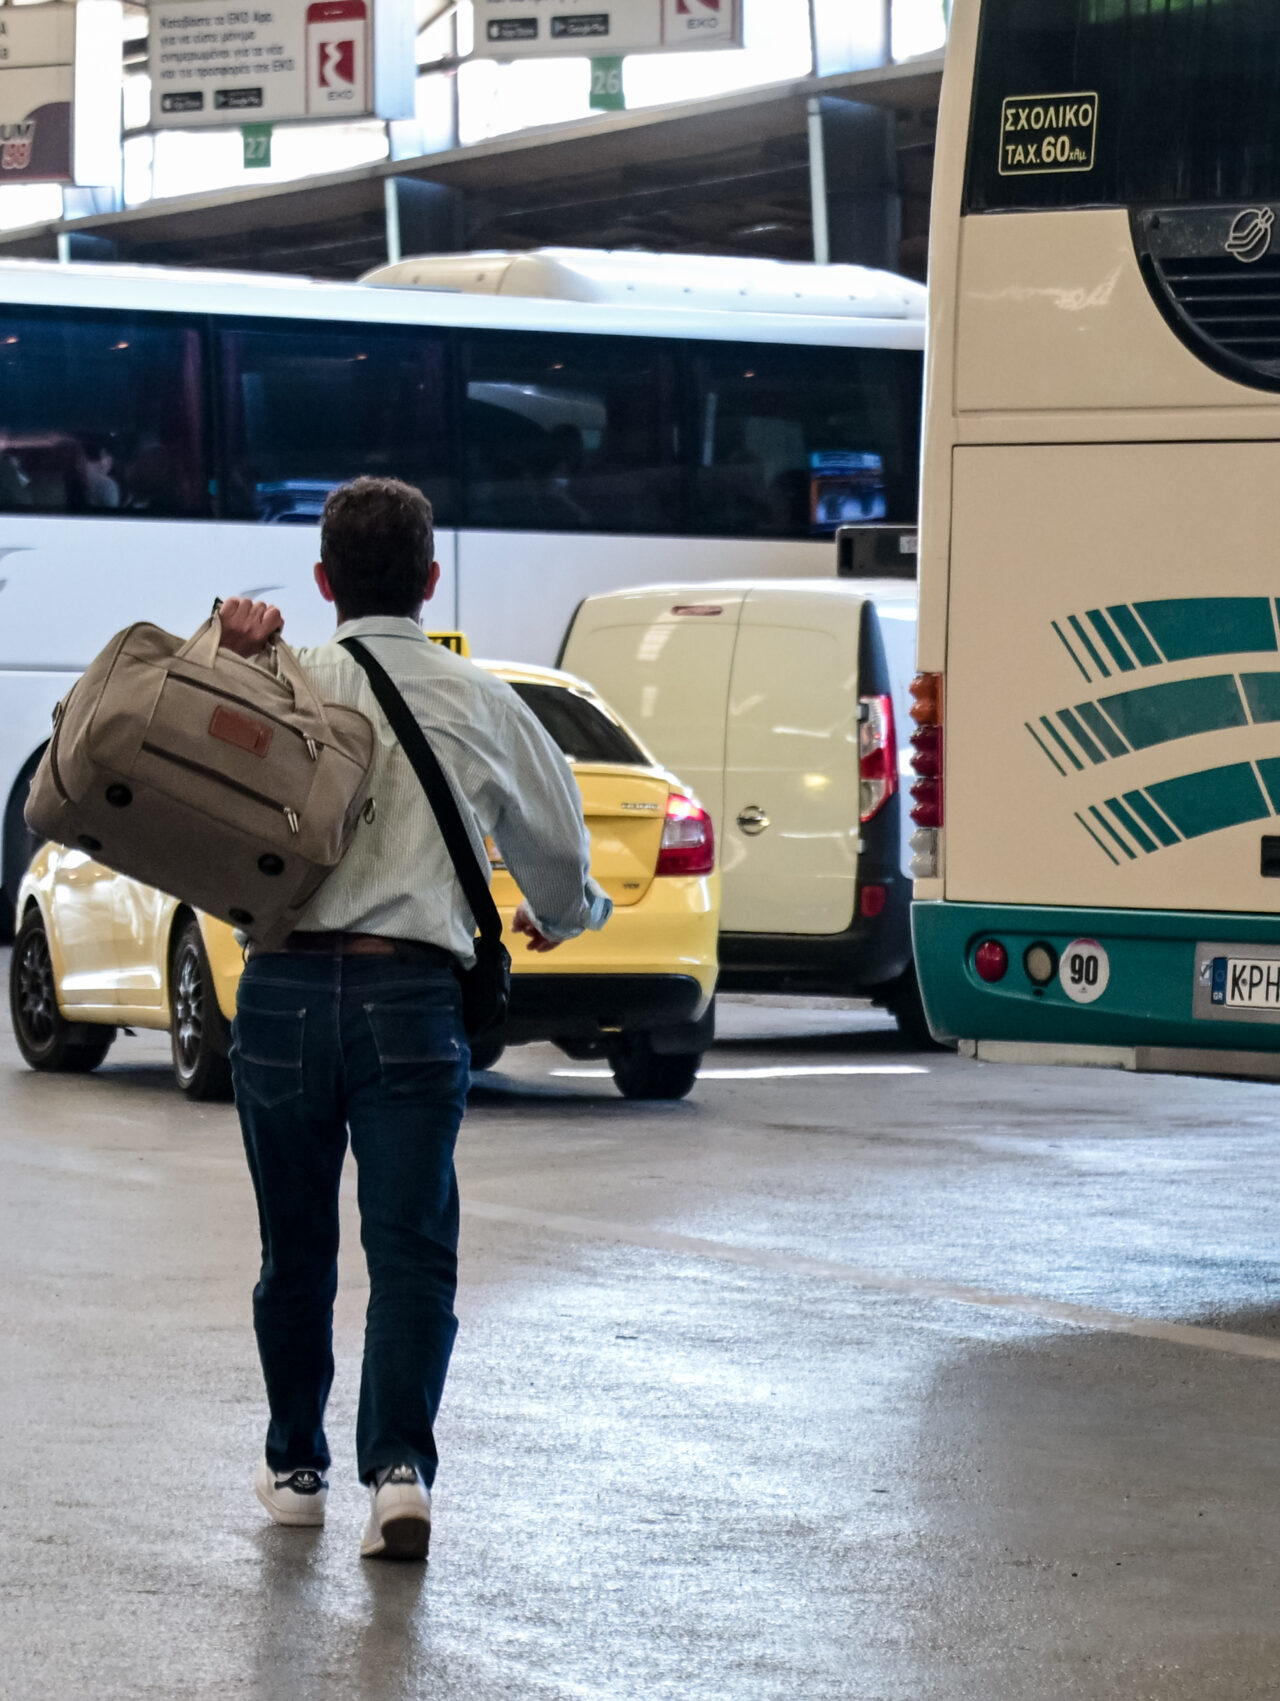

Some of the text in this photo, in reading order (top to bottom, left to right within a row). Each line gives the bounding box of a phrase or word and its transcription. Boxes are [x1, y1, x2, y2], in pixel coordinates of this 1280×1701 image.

[687, 19, 718, 29] EKO
[593, 71, 620, 94] 26
[1005, 104, 1092, 131] ΣΧΟΛΙΚΟ
[245, 137, 268, 158] 27
[1005, 144, 1040, 165] ΤΑΧ.
[1042, 135, 1070, 163] 60
[1070, 954, 1098, 986] 90
[1213, 992, 1223, 1000] GR
